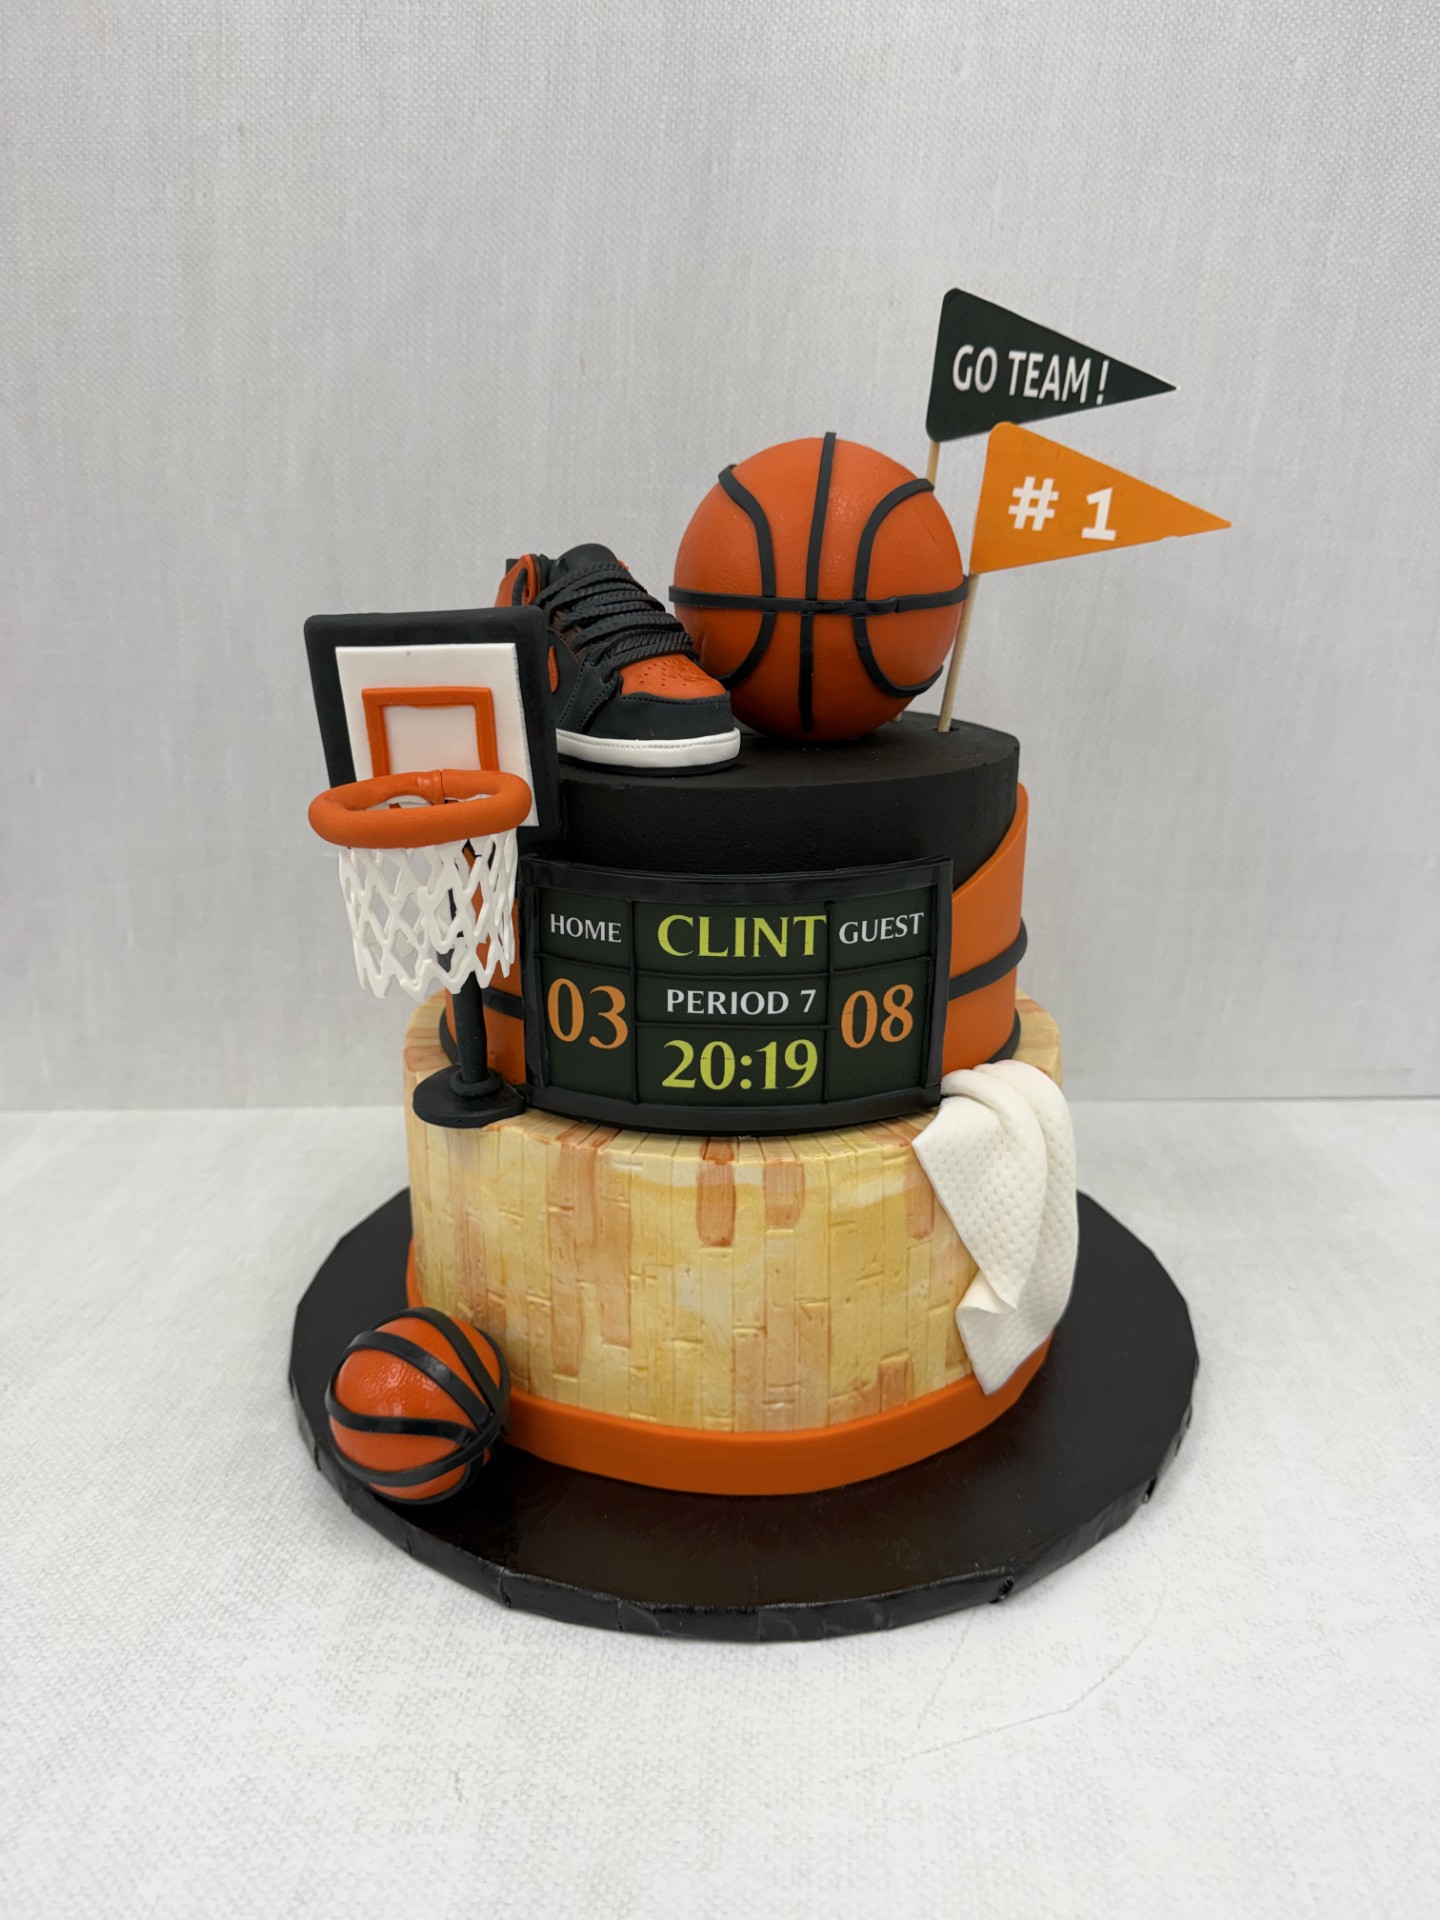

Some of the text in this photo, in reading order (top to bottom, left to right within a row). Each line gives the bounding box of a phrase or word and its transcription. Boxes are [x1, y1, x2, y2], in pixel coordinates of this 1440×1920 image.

[952, 344, 998, 393] GO
[550, 913, 622, 943] HOME
[657, 914, 827, 958] CLINT
[838, 912, 925, 945] GUEST
[547, 977, 629, 1050] 03
[667, 988, 817, 1016] PERIOD 7
[840, 983, 914, 1049] 08
[661, 1038, 818, 1090] 20:19
